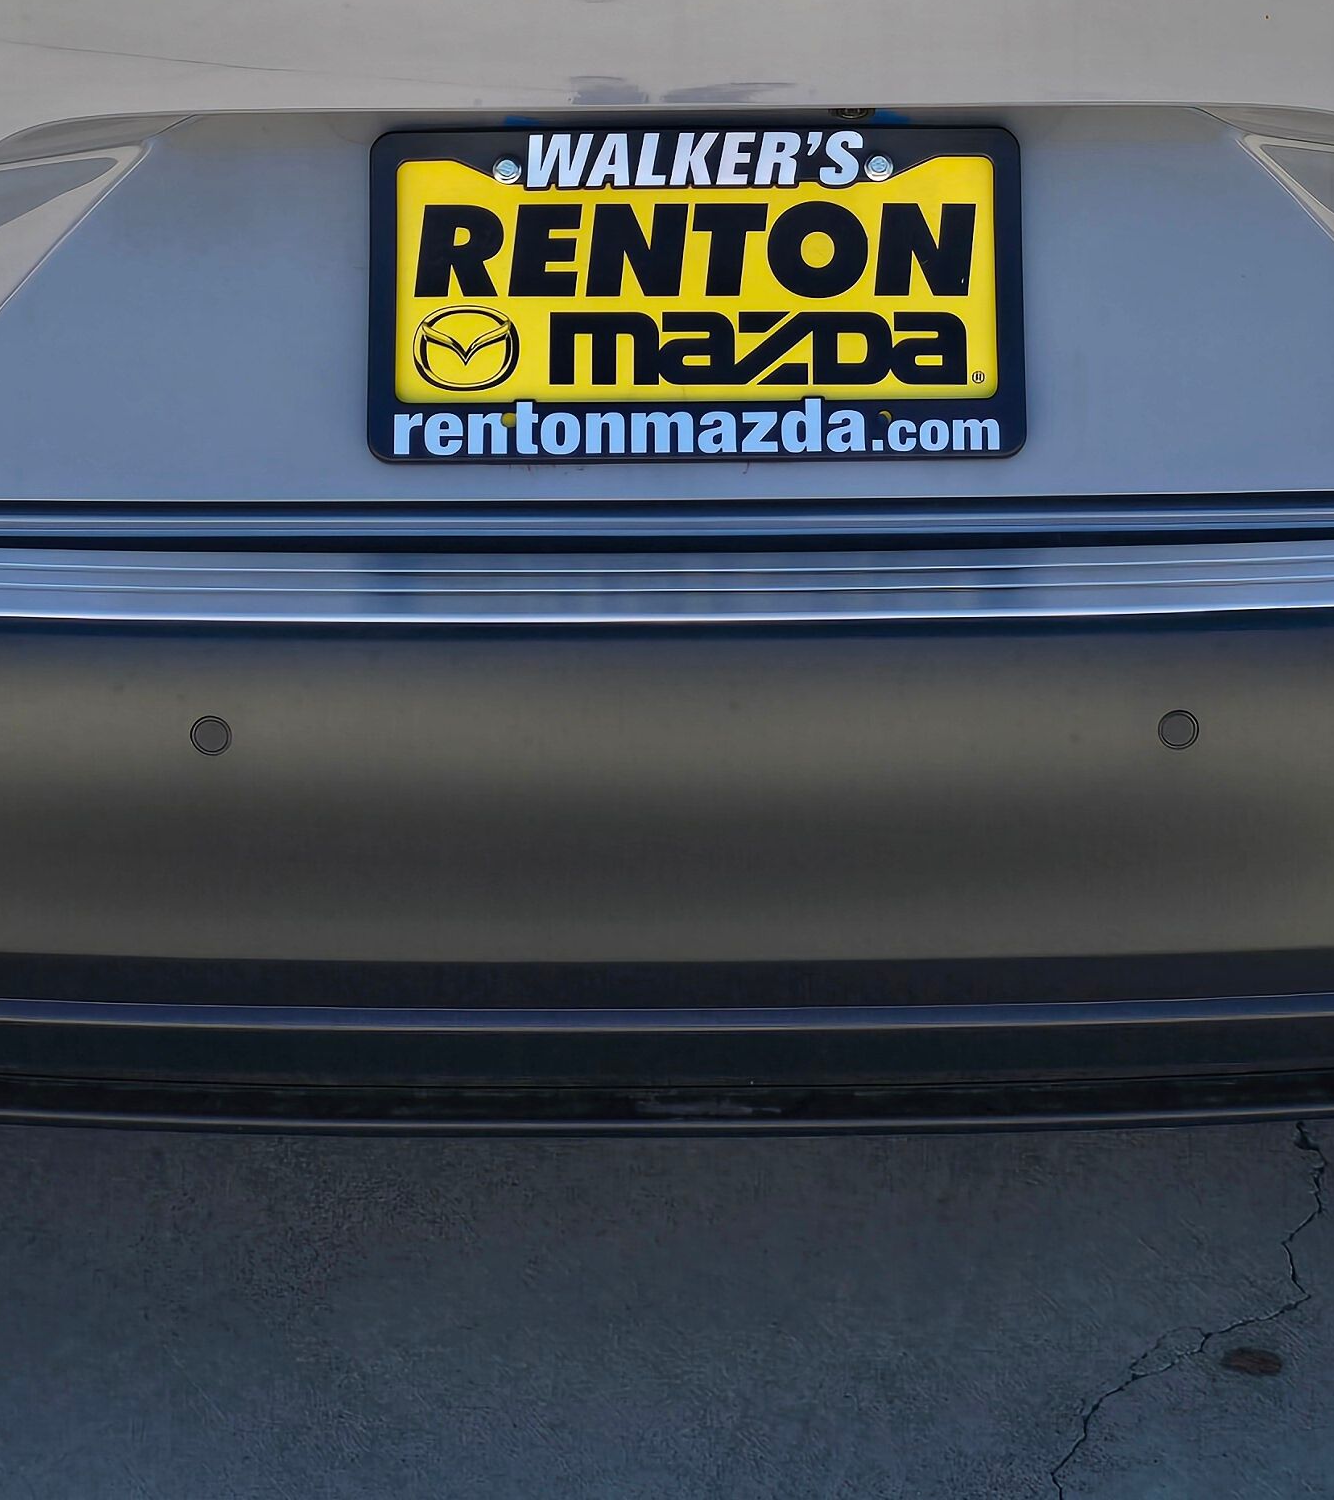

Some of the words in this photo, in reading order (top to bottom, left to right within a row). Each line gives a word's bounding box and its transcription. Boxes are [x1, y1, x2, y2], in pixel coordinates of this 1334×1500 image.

[526, 131, 864, 188] WALKER'S
[414, 200, 975, 298] RENTON
[393, 399, 1000, 455] rentonmazda.com
